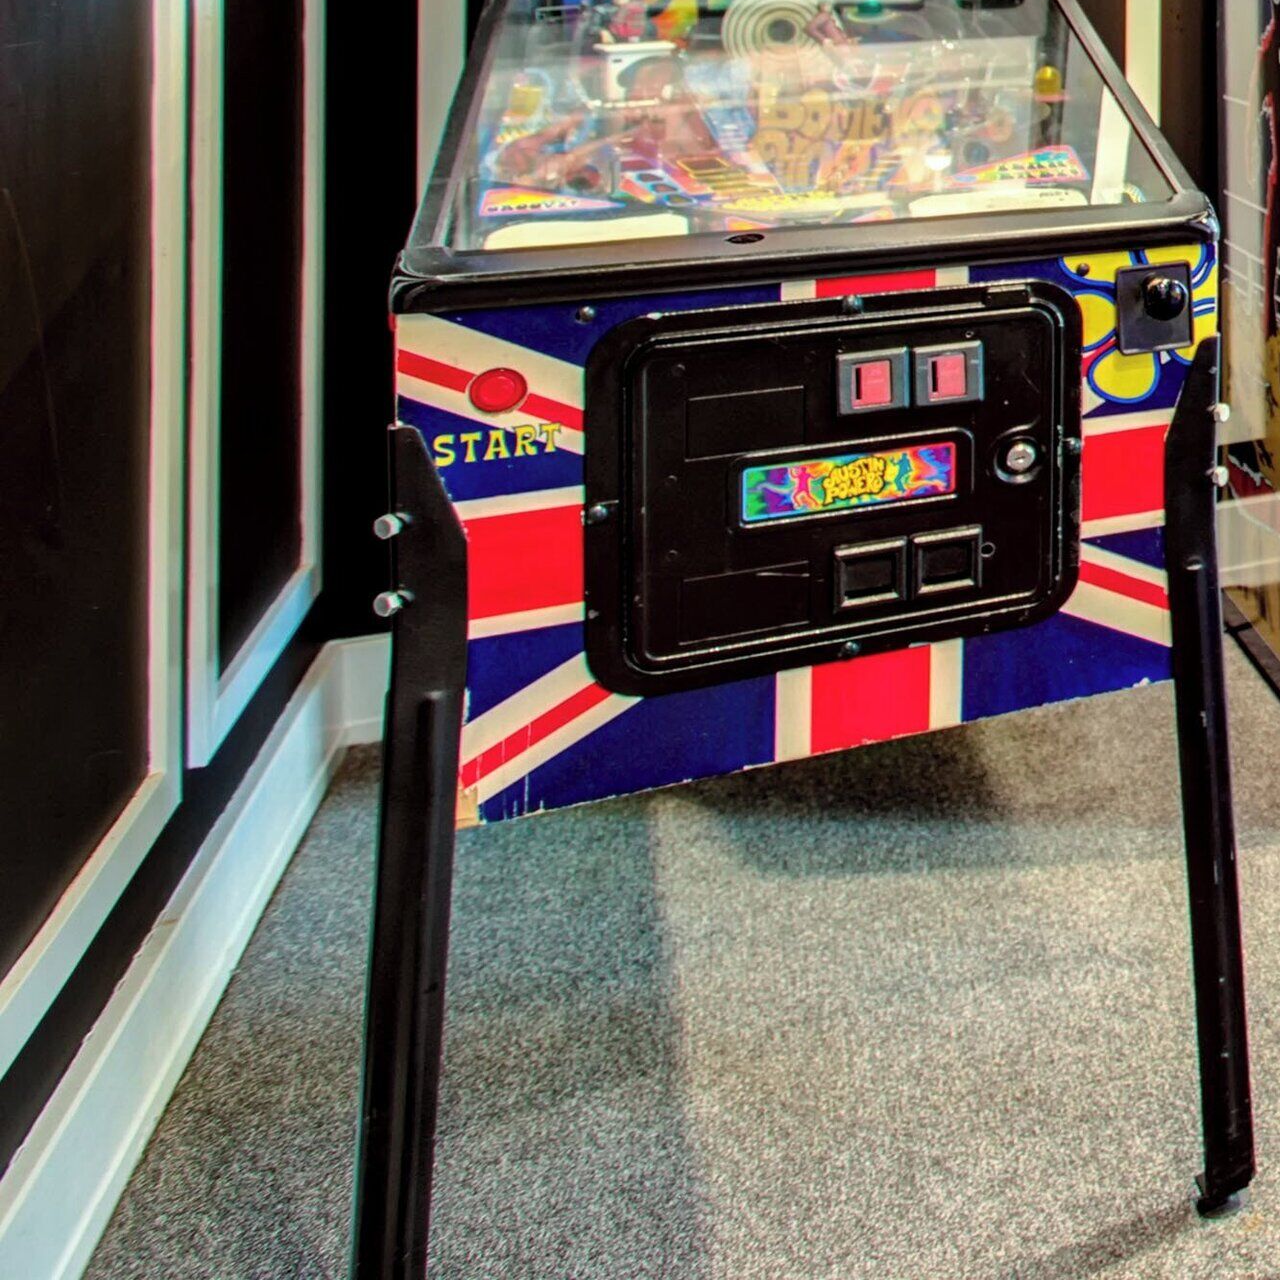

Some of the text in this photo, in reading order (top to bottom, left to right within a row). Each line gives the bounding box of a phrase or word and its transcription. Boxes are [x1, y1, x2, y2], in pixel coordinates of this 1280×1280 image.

[433, 422, 562, 467] START
[823, 455, 887, 489] AUSTIN
[823, 472, 887, 507] POWERS
